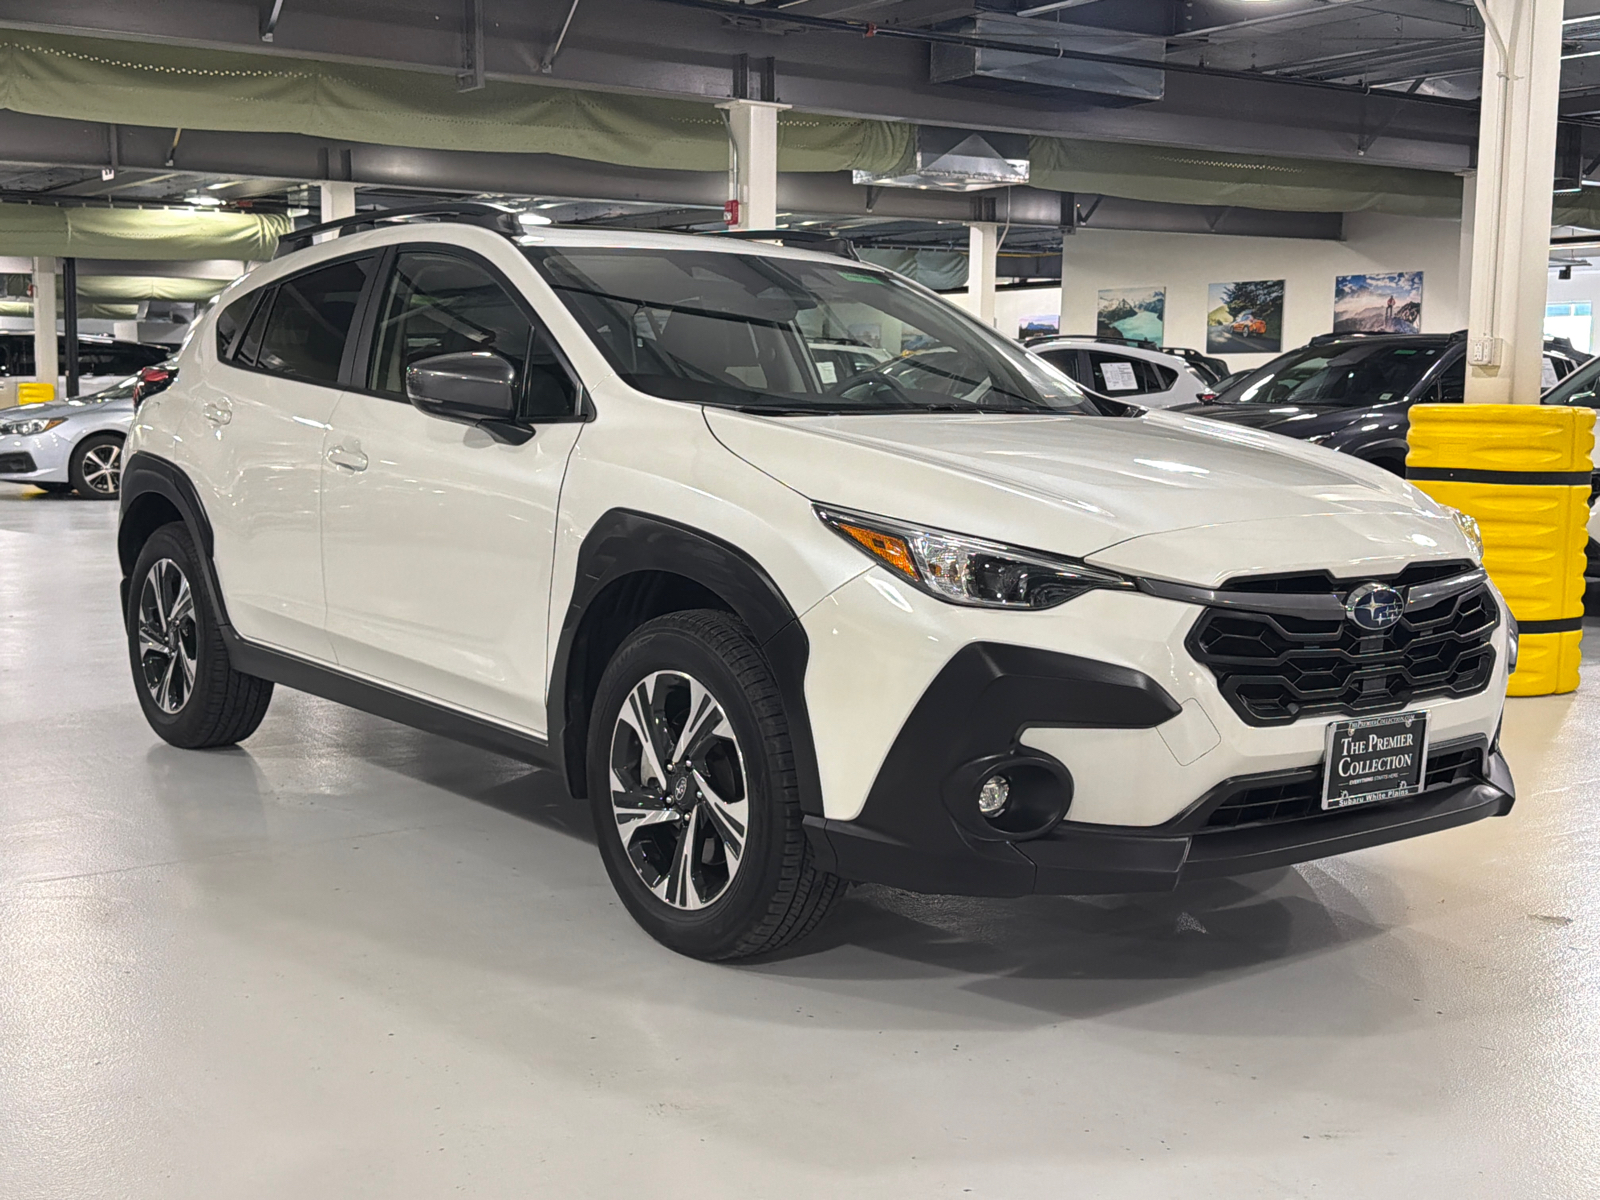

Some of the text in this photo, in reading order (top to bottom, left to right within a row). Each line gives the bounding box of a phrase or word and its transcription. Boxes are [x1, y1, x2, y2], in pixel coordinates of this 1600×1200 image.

[1341, 733, 1413, 756] THE PREMIER
[1338, 753, 1413, 777] COLLECTION
[1348, 776, 1374, 786] EVERYTHING
[1338, 789, 1409, 807] Subaru White Plains
